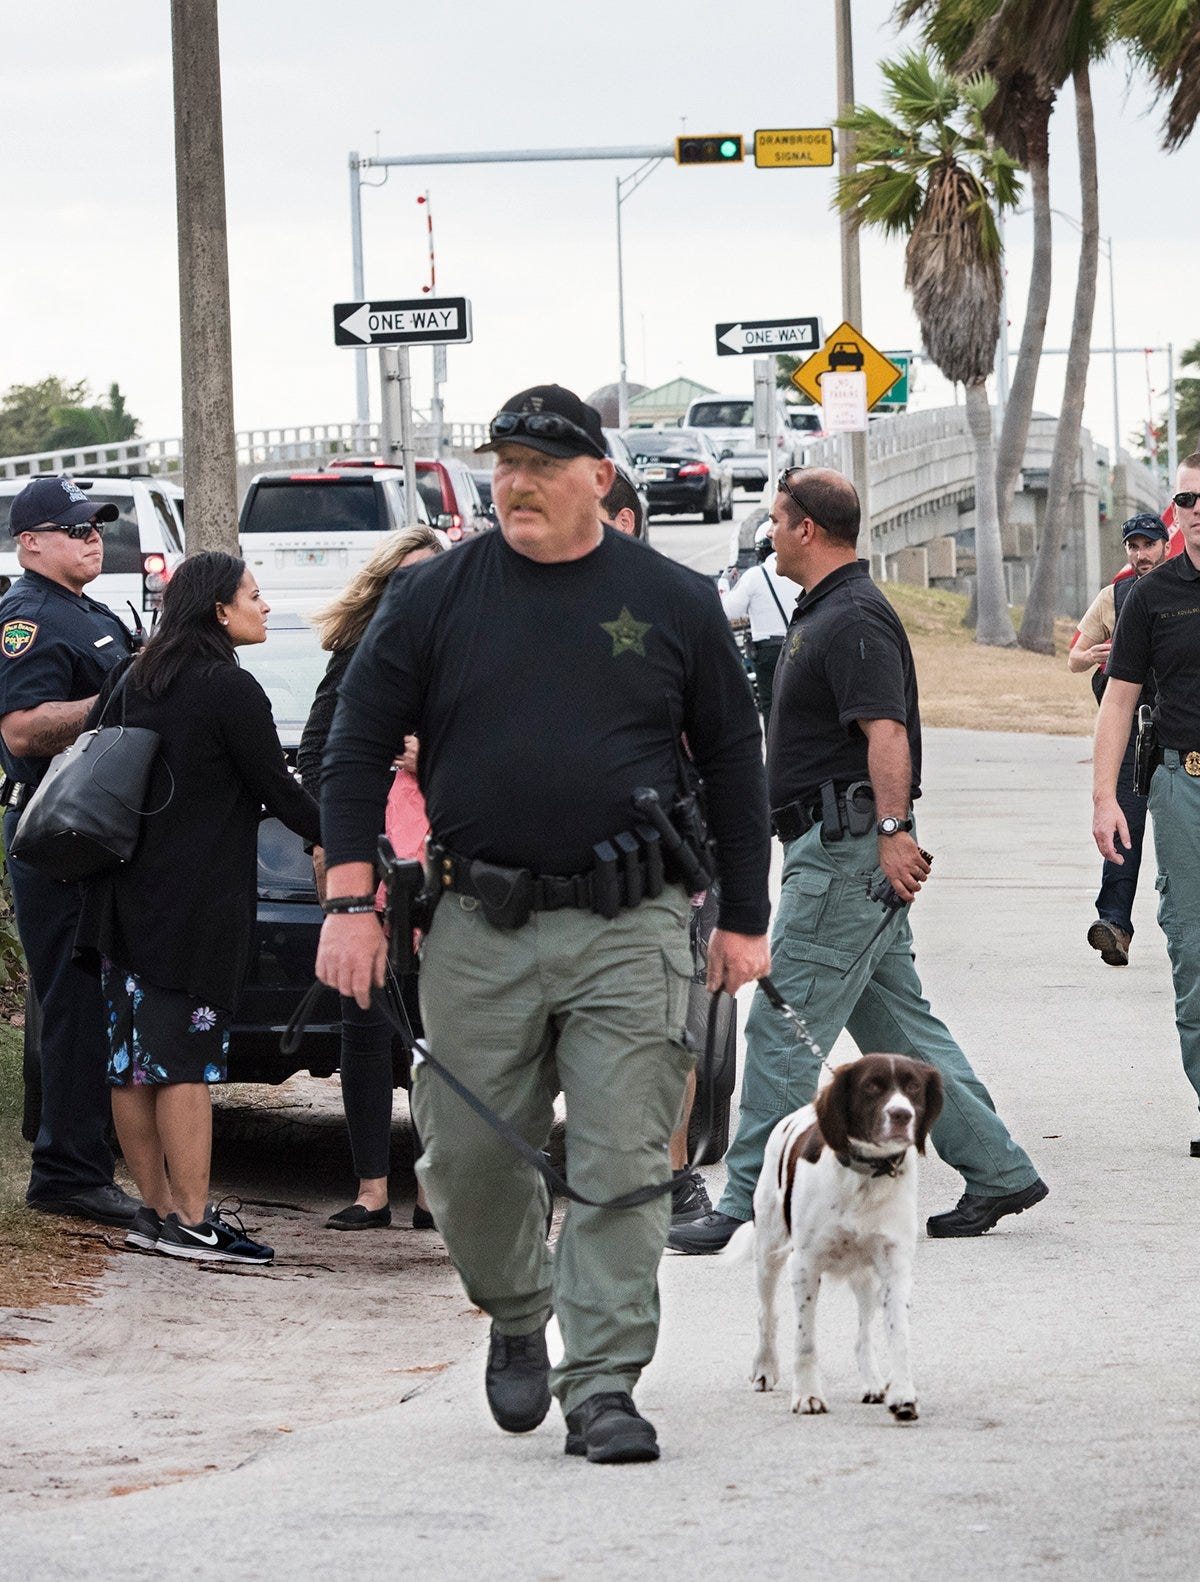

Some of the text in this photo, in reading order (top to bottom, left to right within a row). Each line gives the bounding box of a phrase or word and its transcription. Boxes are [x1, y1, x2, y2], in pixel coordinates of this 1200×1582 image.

[759, 134, 828, 145] DRAWBRIDGE
[774, 151, 813, 162] SIGNAL
[368, 311, 452, 331] ONE WAY
[745, 328, 806, 344] ONE WAY
